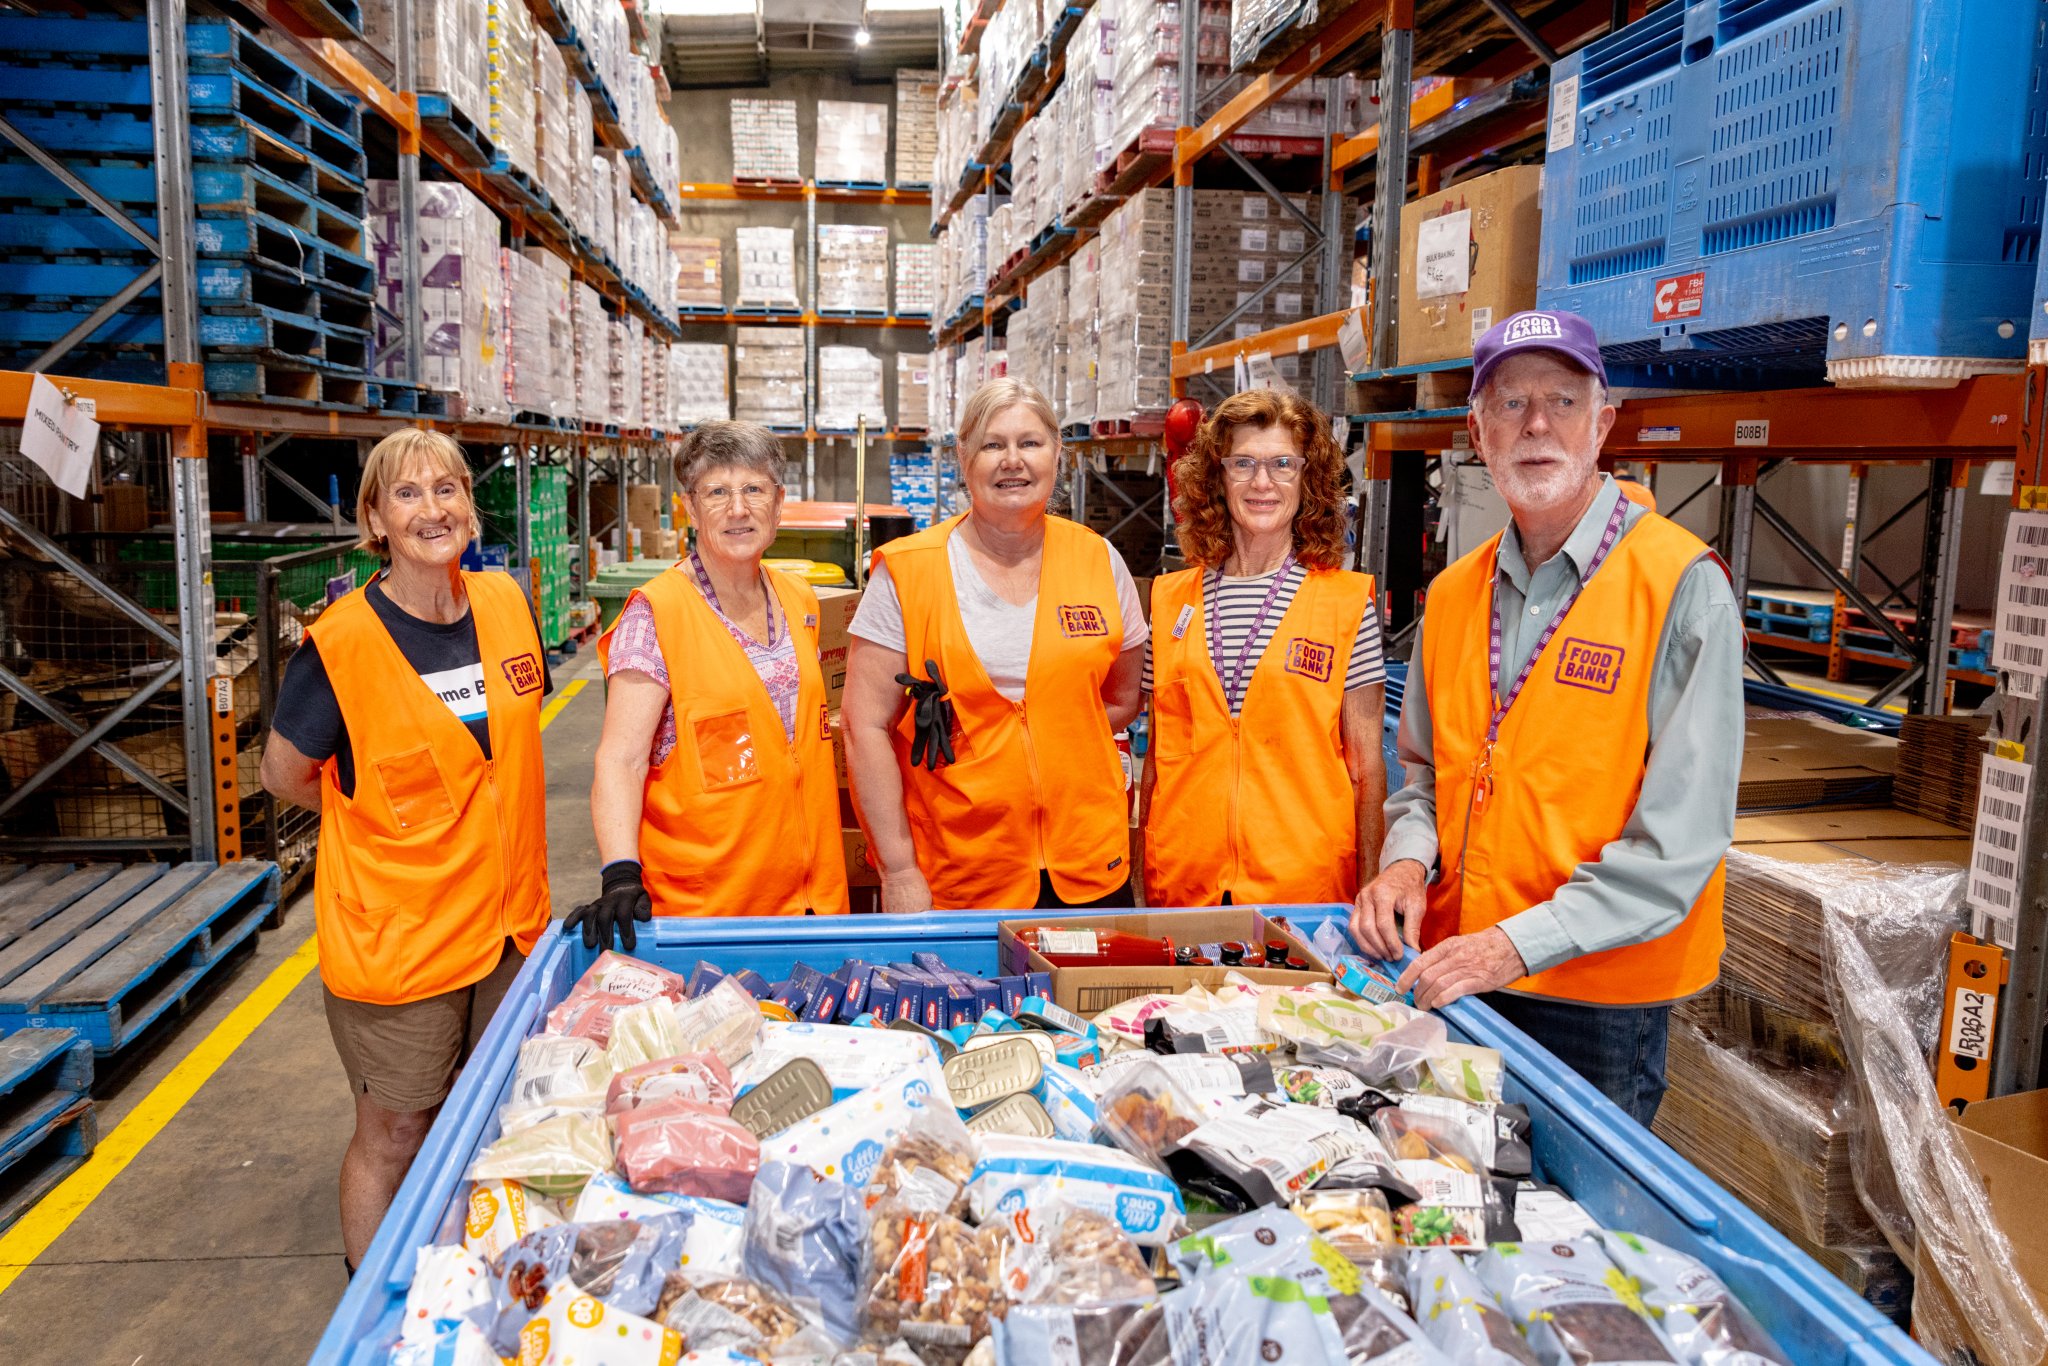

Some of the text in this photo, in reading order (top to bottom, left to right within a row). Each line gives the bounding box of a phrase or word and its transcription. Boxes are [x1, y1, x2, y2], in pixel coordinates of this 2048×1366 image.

[1513, 317, 1550, 329] FOOD
[1512, 326, 1552, 339] BANK
[34, 408, 80, 453] MIXED PANTRY
[1736, 425, 1767, 439] B08B1
[1065, 610, 1096, 622] FOOD
[1067, 621, 1101, 632] BANK
[1295, 643, 1326, 663] FOOD
[1569, 647, 1612, 668] FOOD
[510, 660, 532, 677] FOOD
[1292, 655, 1323, 675] BANK
[1565, 662, 1609, 684] BANK
[516, 674, 538, 689] BANK
[219, 679, 228, 710] B07A2
